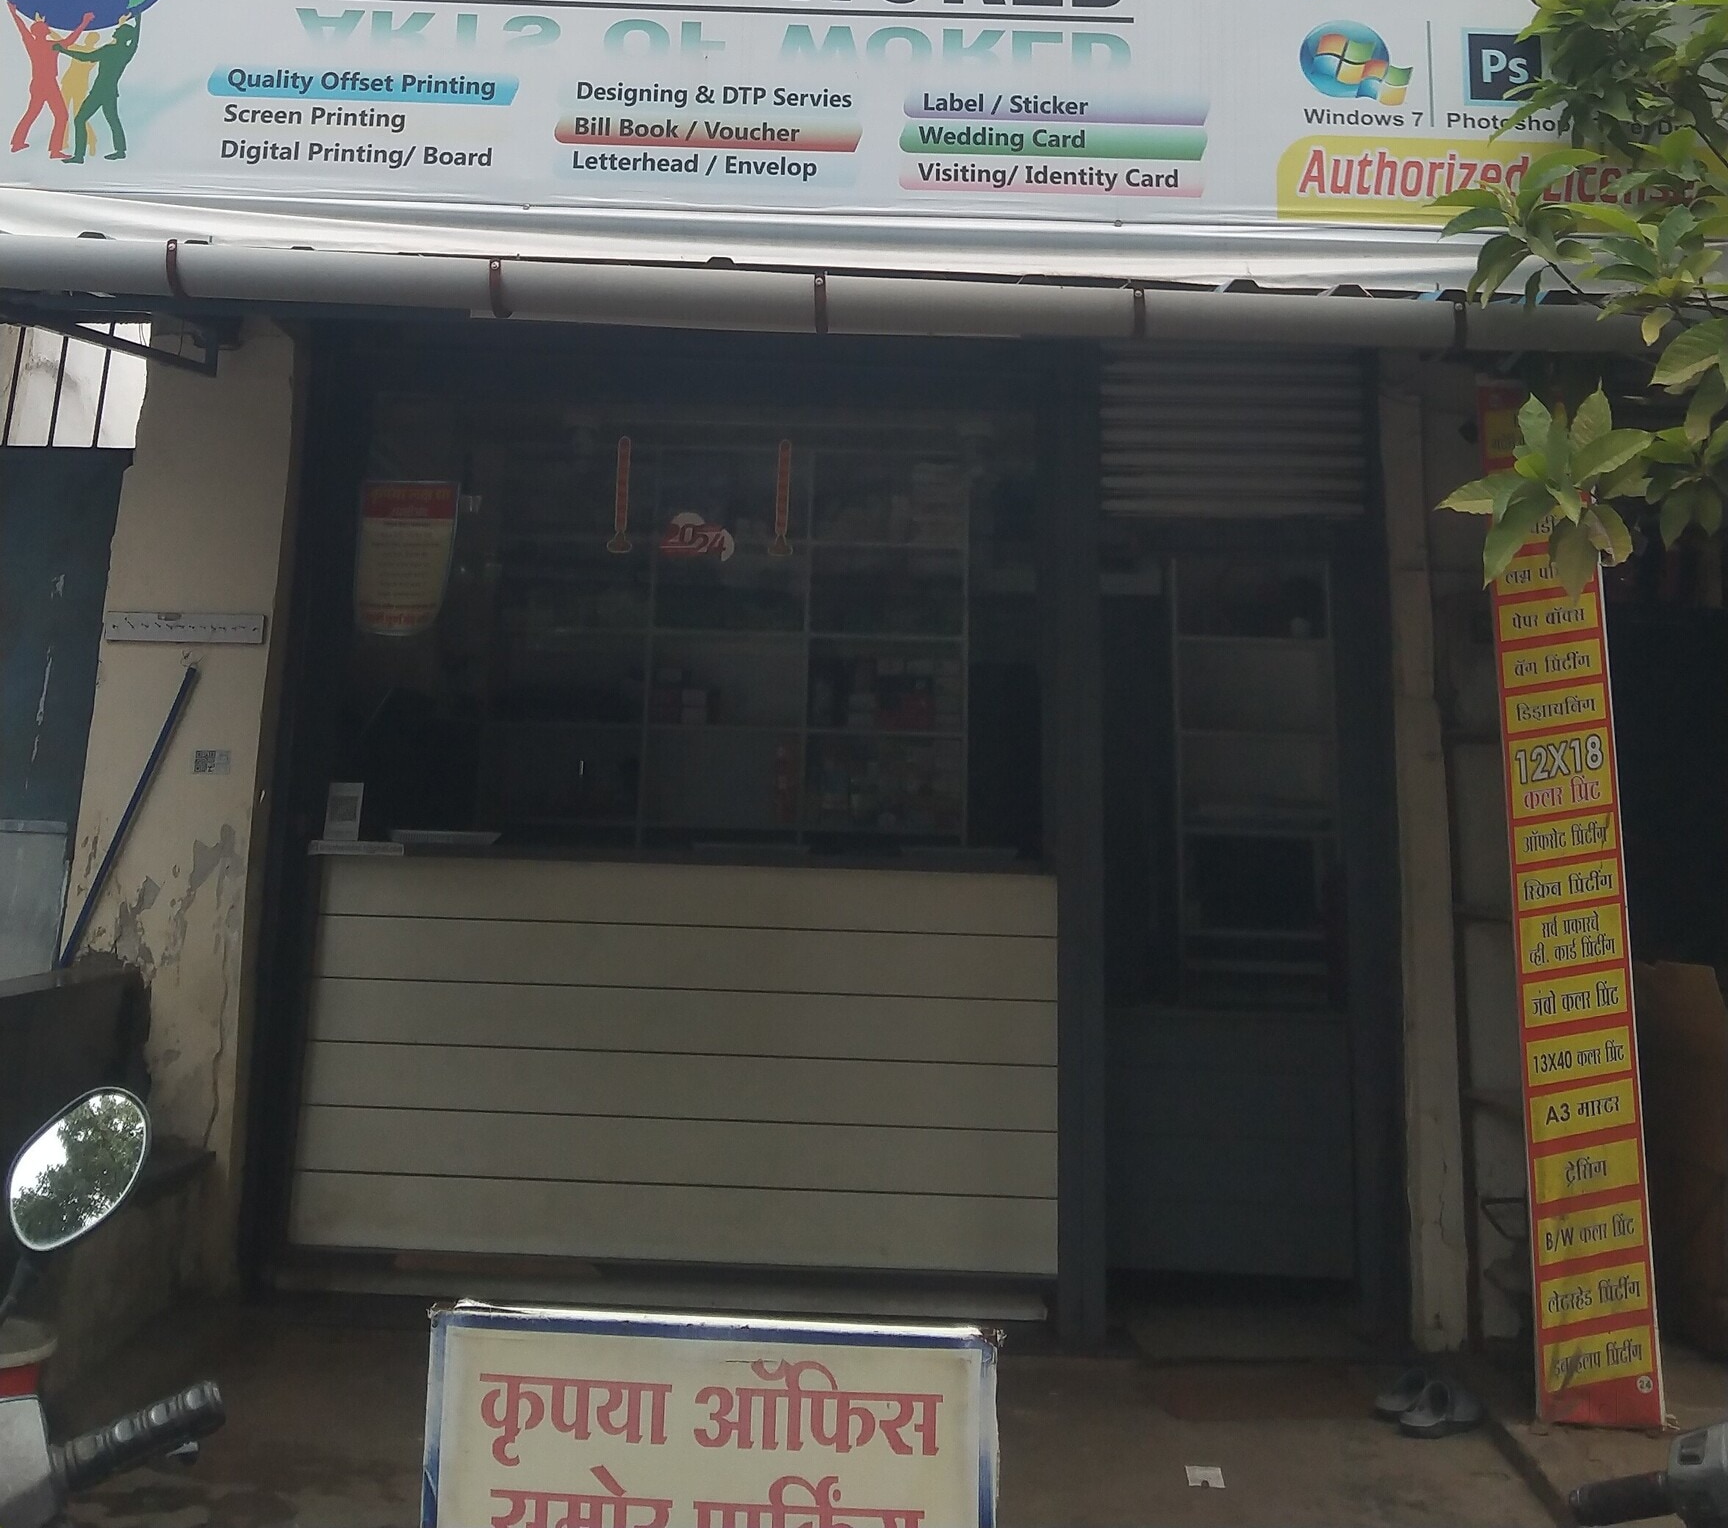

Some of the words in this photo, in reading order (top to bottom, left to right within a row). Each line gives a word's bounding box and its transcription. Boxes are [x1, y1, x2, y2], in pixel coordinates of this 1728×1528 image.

[1481, 49, 1530, 85] Ps
[227, 67, 314, 95] Quality
[321, 70, 394, 93] Offset
[401, 73, 497, 101] Printing
[576, 81, 688, 109] Designing
[695, 85, 715, 105] &
[722, 86, 767, 106] DTP
[773, 87, 853, 108] Servies
[223, 104, 303, 127] Screen
[310, 106, 407, 133] Printing
[923, 91, 984, 113] Label
[990, 94, 1003, 116] /
[1009, 94, 1089, 117] Sticker
[1303, 108, 1405, 128] Windows
[1412, 111, 1424, 128] 7
[574, 116, 611, 138] Bill
[619, 118, 680, 140] Book
[685, 120, 698, 142] /
[704, 120, 800, 143] Voucher
[918, 125, 1025, 153] Wedding
[1032, 128, 1086, 150] Card
[219, 139, 300, 166] Digital
[423, 146, 493, 168] Board
[572, 149, 700, 174] Letterhead
[704, 154, 718, 177] /
[724, 155, 818, 182] Envelop
[1025, 165, 1118, 192] Identity
[1124, 168, 1180, 190] Card
[1299, 148, 1531, 200] Authorized
[1545, 606, 1585, 626] बॉक्स
[1545, 650, 1591, 674] प्रिंटींग
[1516, 695, 1596, 723] डिझायनिंग
[1515, 733, 1604, 786] 12X18
[1524, 786, 1563, 810] कलर
[1570, 775, 1602, 804] प्रिंट
[1522, 827, 1567, 853] ऑफसेट
[1571, 820, 1608, 848] प्रिंटींग
[1569, 869, 1614, 896] प्रिंटींग
[1541, 917, 1559, 939] सर्व
[1563, 910, 1600, 936] प्रकारचे
[1554, 941, 1578, 962] कार्ड
[1581, 935, 1616, 960] प्रिंटींग
[1531, 990, 1557, 1017] जंबो
[1561, 990, 1592, 1013] कलर
[1596, 980, 1620, 1009] प्रिंट
[1533, 1050, 1573, 1074] 13X40
[1577, 1048, 1602, 1068] कलर
[1605, 1039, 1625, 1064] प्रिंट
[1545, 1103, 1571, 1126] A3
[1577, 1095, 1620, 1118] मास्टर
[1545, 1226, 1574, 1252] B/W
[1612, 1212, 1635, 1238] प्रिंट
[1597, 1274, 1641, 1304] प्रिंटींग
[479, 1372, 673, 1467] कृपया
[692, 1357, 945, 1457] ऑफिस
